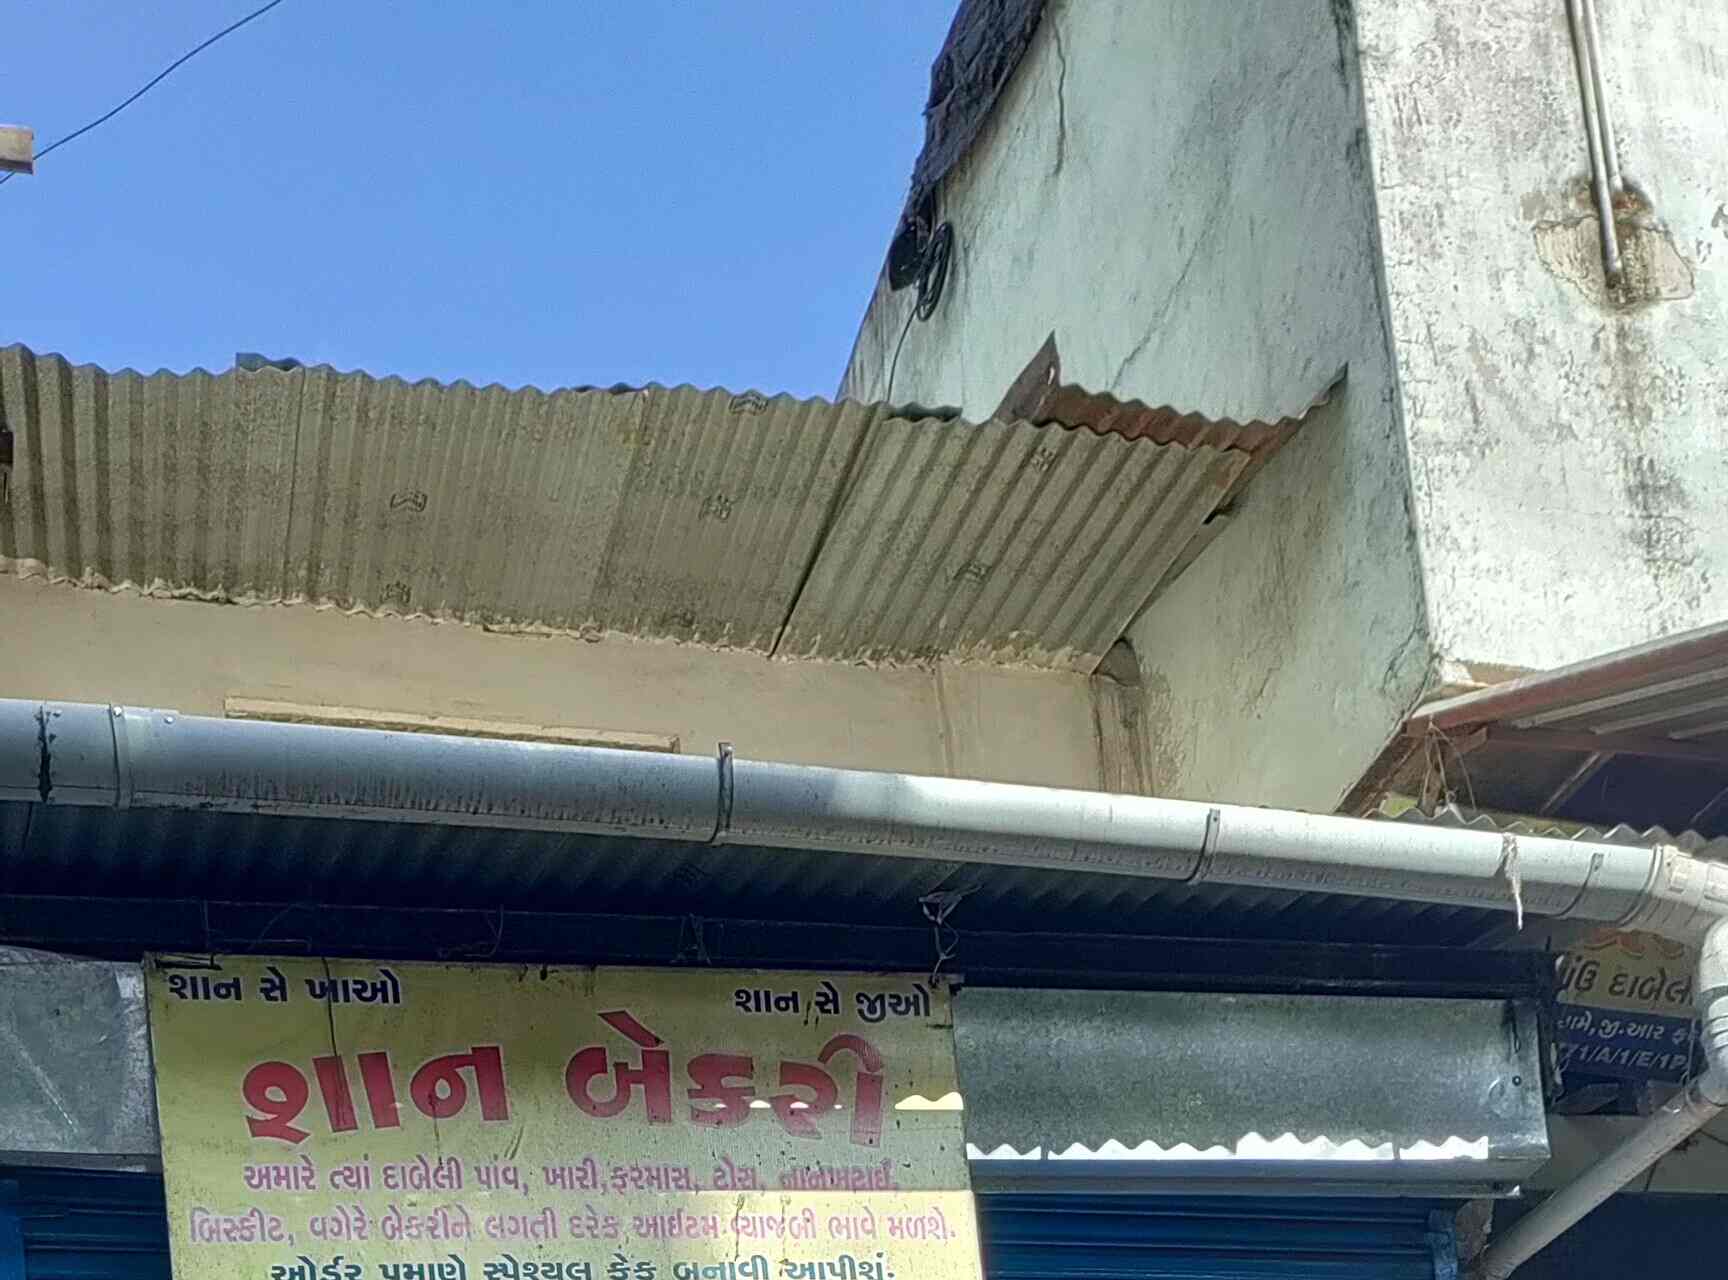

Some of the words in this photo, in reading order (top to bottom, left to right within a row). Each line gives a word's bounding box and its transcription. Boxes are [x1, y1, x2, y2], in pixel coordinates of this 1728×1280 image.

[169, 974, 241, 1002] શાન
[260, 967, 288, 1002] સે
[304, 968, 400, 1004] ખાઓ
[734, 988, 799, 1015] શાન
[815, 981, 840, 1015] સે
[855, 983, 930, 1022] જીઓ
[242, 1045, 509, 1144] શાન
[565, 1009, 884, 1148] બેકરી
[244, 1154, 317, 1191] અમારે
[328, 1153, 371, 1190] ત્યાં
[382, 1155, 464, 1190] દાબેલી
[484, 1207, 559, 1240] લગતી
[569, 1204, 620, 1240] દરેક
[828, 1206, 878, 1240] ભાવે
[607, 1253, 656, 1280] કેક
[673, 1255, 768, 1280] બનાવી
